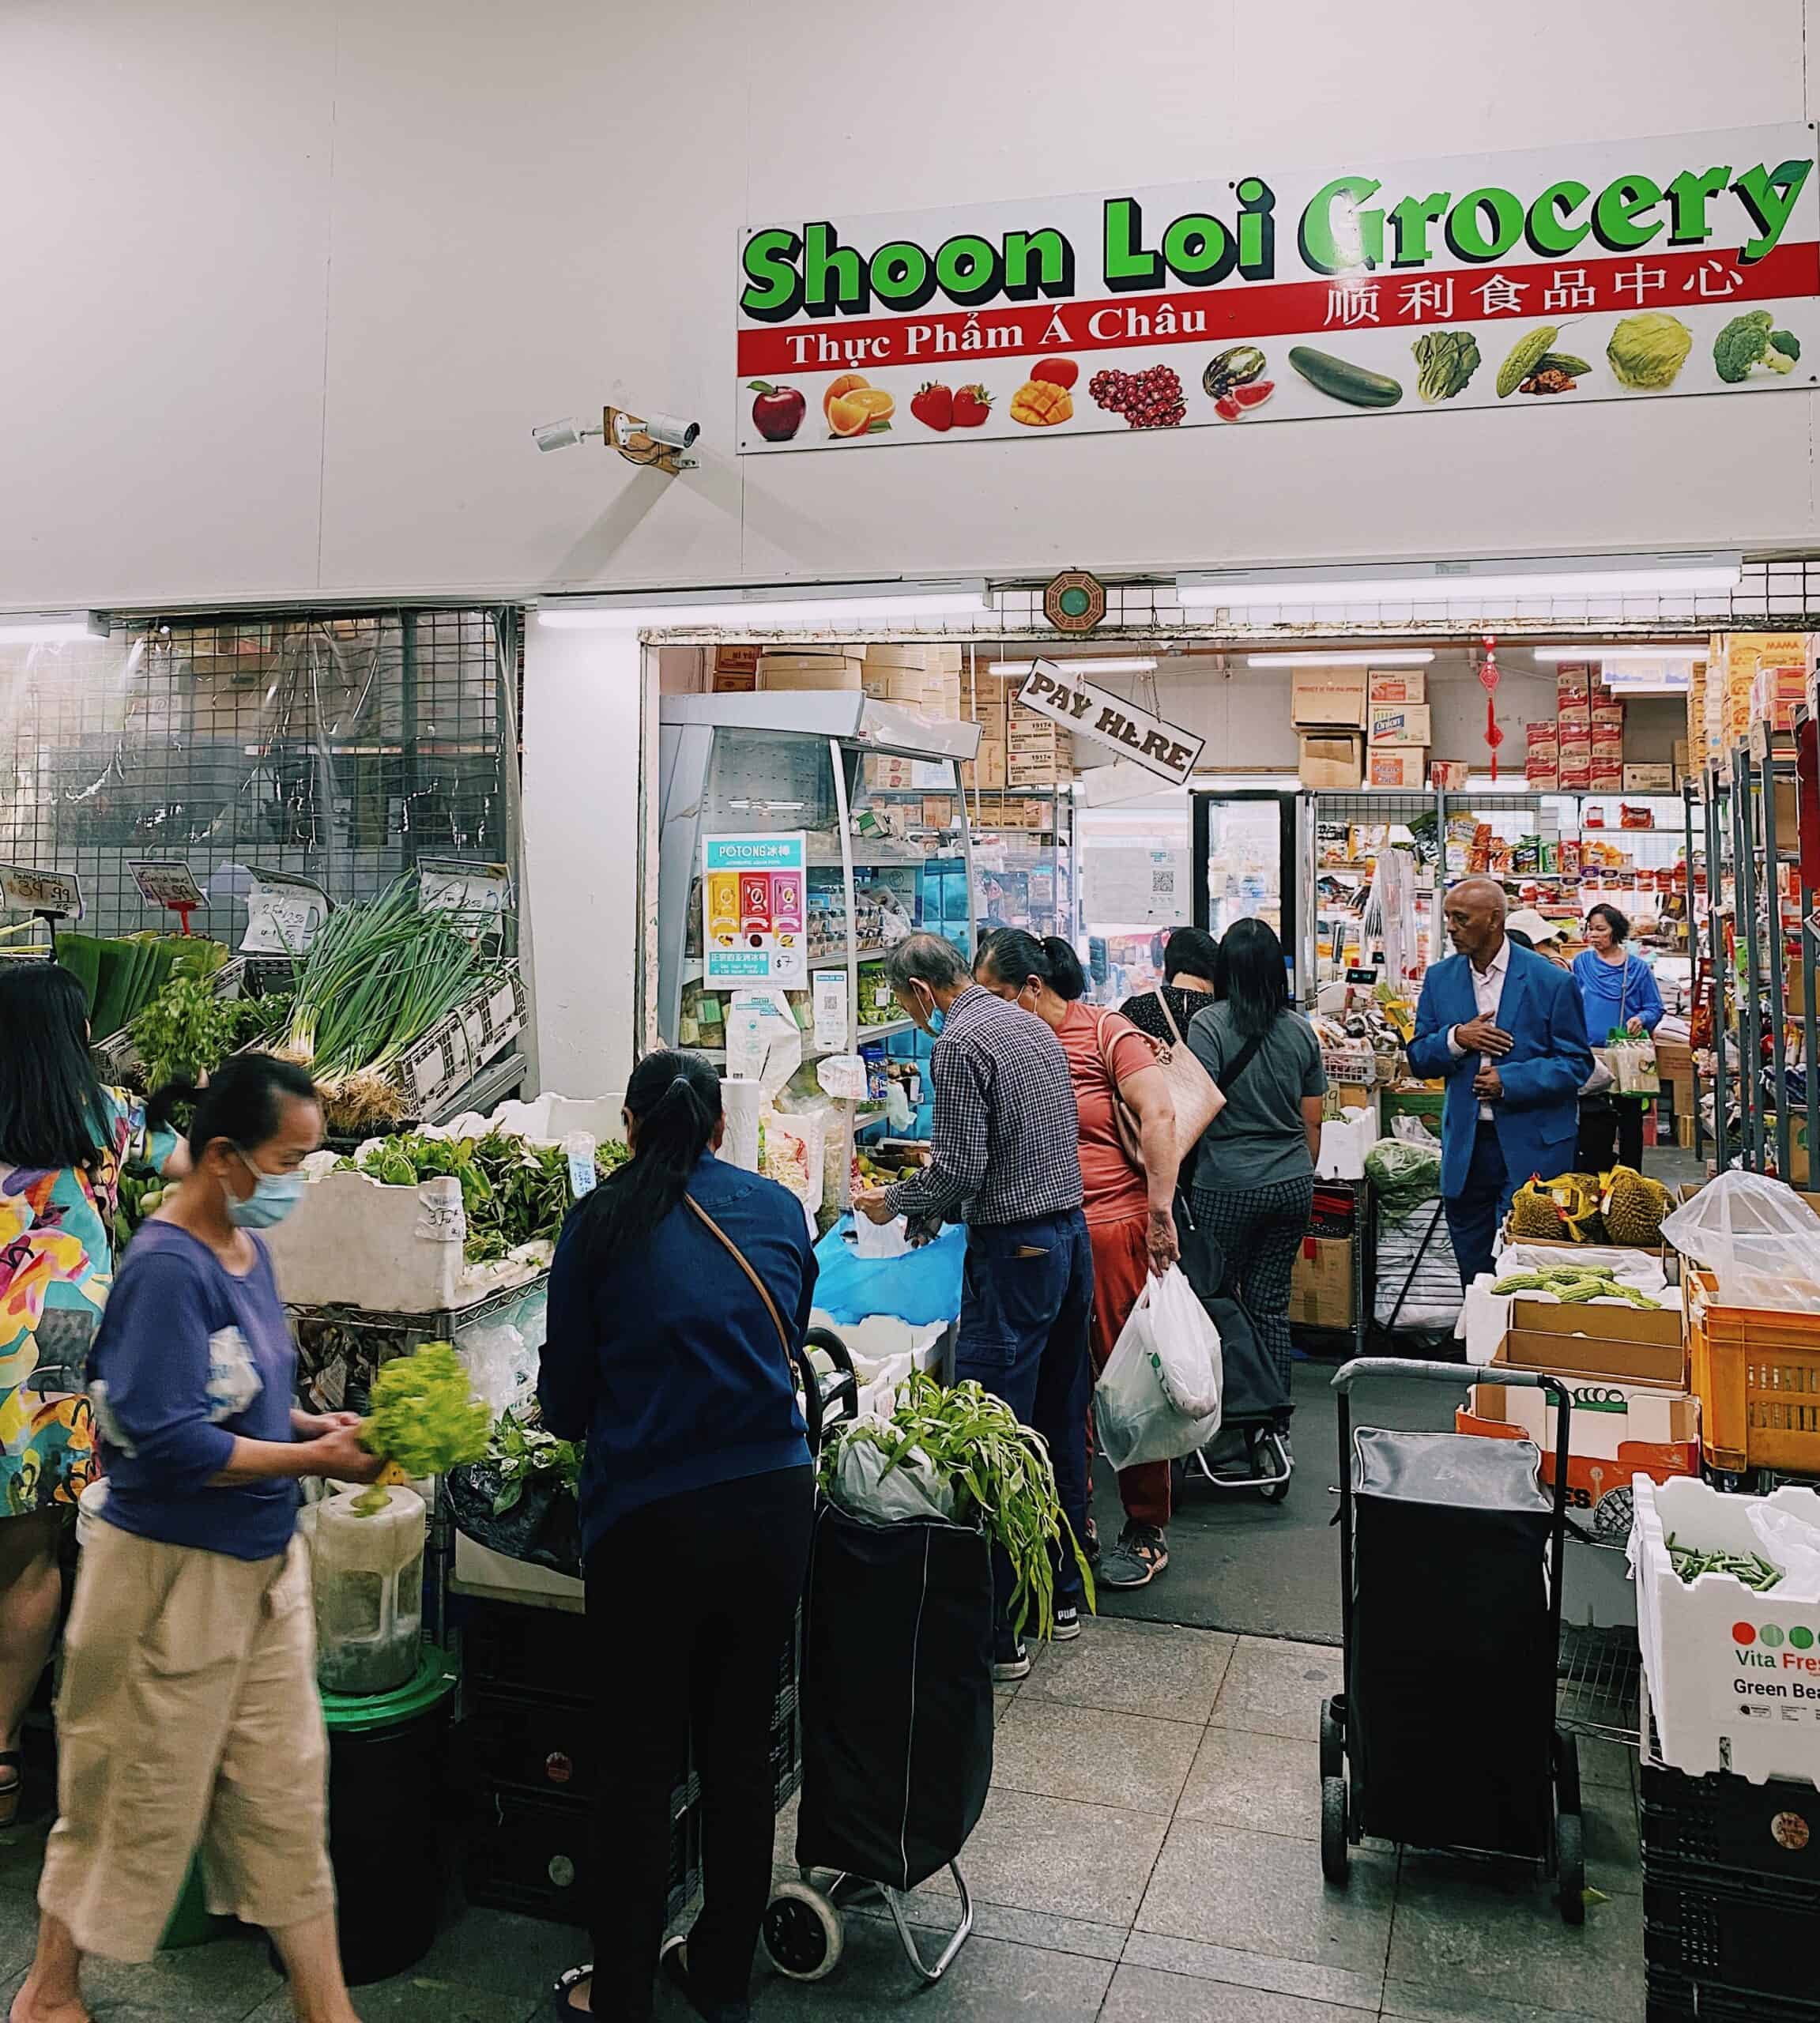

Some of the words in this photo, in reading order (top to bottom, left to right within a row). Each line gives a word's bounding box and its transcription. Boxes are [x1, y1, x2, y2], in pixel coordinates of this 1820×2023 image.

[740, 220, 1075, 322] Shoon
[1103, 176, 1275, 292] Loi
[1298, 158, 1814, 275] Grocery
[1323, 258, 1744, 327] 顺利食品中心
[786, 327, 891, 367] Thực
[904, 311, 1025, 358] Phẩm
[1039, 304, 1074, 345] Á
[1088, 302, 1208, 341] Châu
[1027, 671, 1093, 720] PAY
[1094, 706, 1193, 772] HERE
[719, 846, 766, 857] POTONG
[1733, 1678, 1788, 1697] Green
[1735, 1649, 1777, 1668] Vita
[1782, 1653, 1820, 1671] Fre
